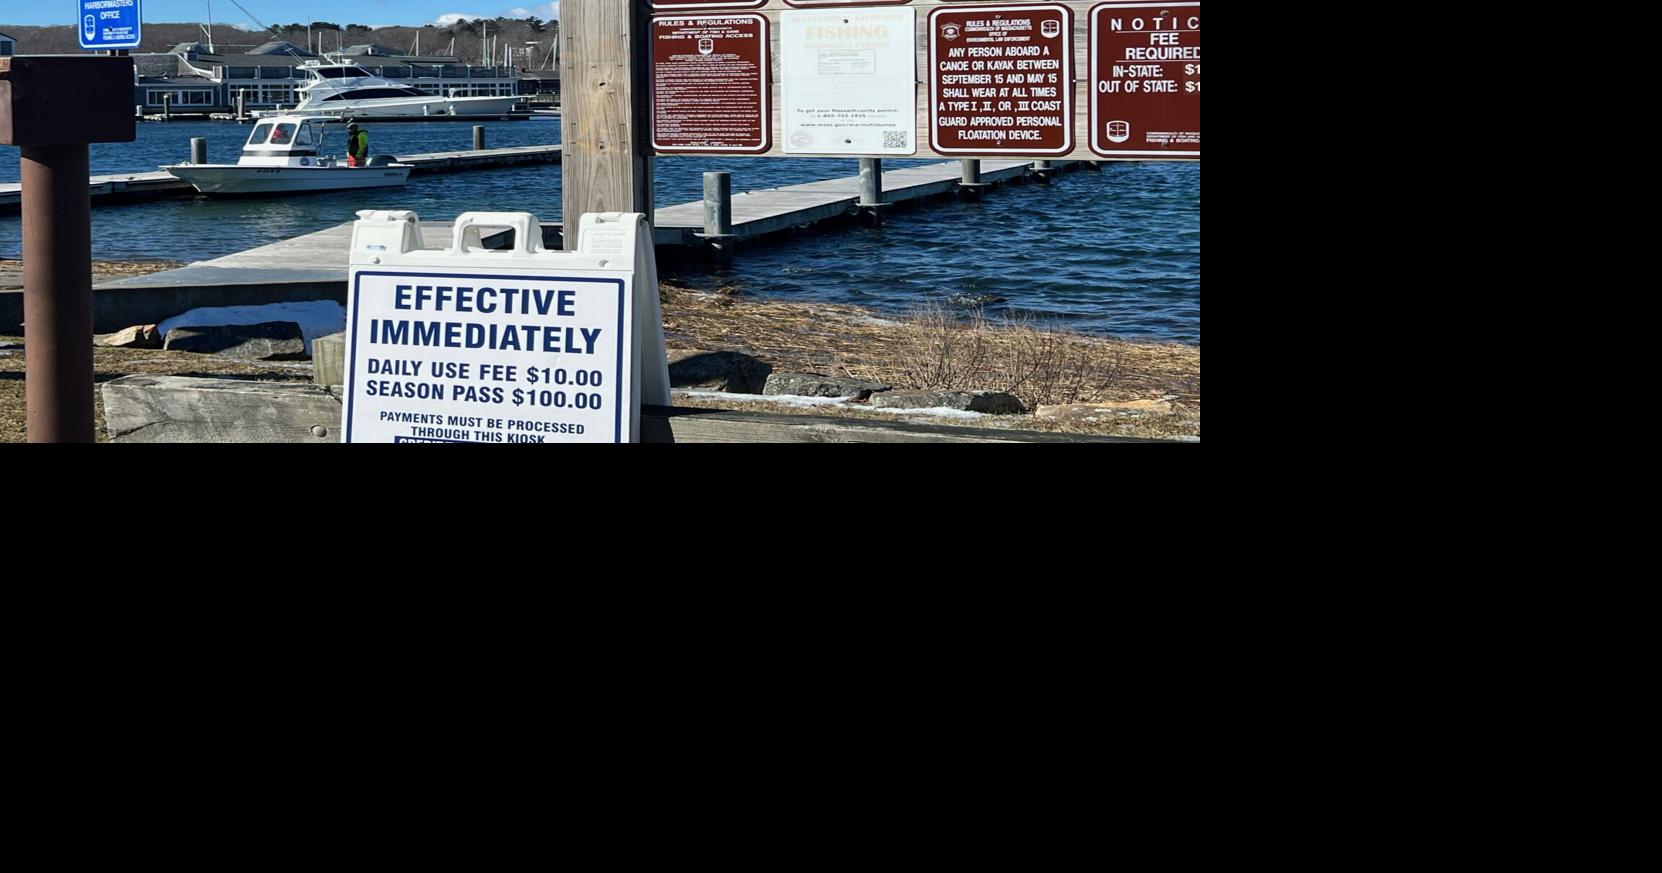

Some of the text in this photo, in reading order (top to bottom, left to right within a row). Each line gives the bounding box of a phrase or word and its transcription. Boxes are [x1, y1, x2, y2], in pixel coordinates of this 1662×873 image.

[100, 10, 120, 20] OFFICE
[697, 18, 754, 26] REGULATIONS
[992, 19, 1031, 27] REGULATIONS
[805, 24, 889, 39] FISHING
[1150, 32, 1180, 46] FEE
[948, 46, 1050, 58] ANY PERSON ABOARD A
[1125, 46, 1200, 60] REQUIRED
[940, 60, 1059, 71] CANOE OR KAYAK BETWEEN
[1112, 64, 1164, 78] IN-STATE:
[942, 73, 1057, 84] SEPTEMBER 15 AND MAY 15
[943, 87, 1057, 98] SHALL WEAR AT ALL TIMES
[1098, 80, 1121, 93] OUT
[1124, 80, 1140, 93] OF
[1143, 80, 1178, 93] STATE:
[939, 101, 946, 112] A
[947, 101, 970, 111] TYPE
[970, 101, 977, 111] I
[998, 101, 1012, 111] OR
[1031, 100, 1061, 111] COAST
[939, 116, 1062, 127] GUARD APPROVED PERSONAL
[958, 130, 1042, 140] FLOATATION DEVICE.
[394, 285, 577, 316] EFFECTIVE
[369, 319, 603, 355] IMMEDIATELY
[367, 358, 603, 387] DAILY USE FEE $10.00
[366, 380, 602, 410] SEASON PASS $100.00
[380, 411, 585, 435] PAYMENTS MUST BE PROCESSED
[411, 426, 470, 440] THROUGH
[474, 430, 503, 443] THIS
[507, 432, 545, 444] KIOSK
